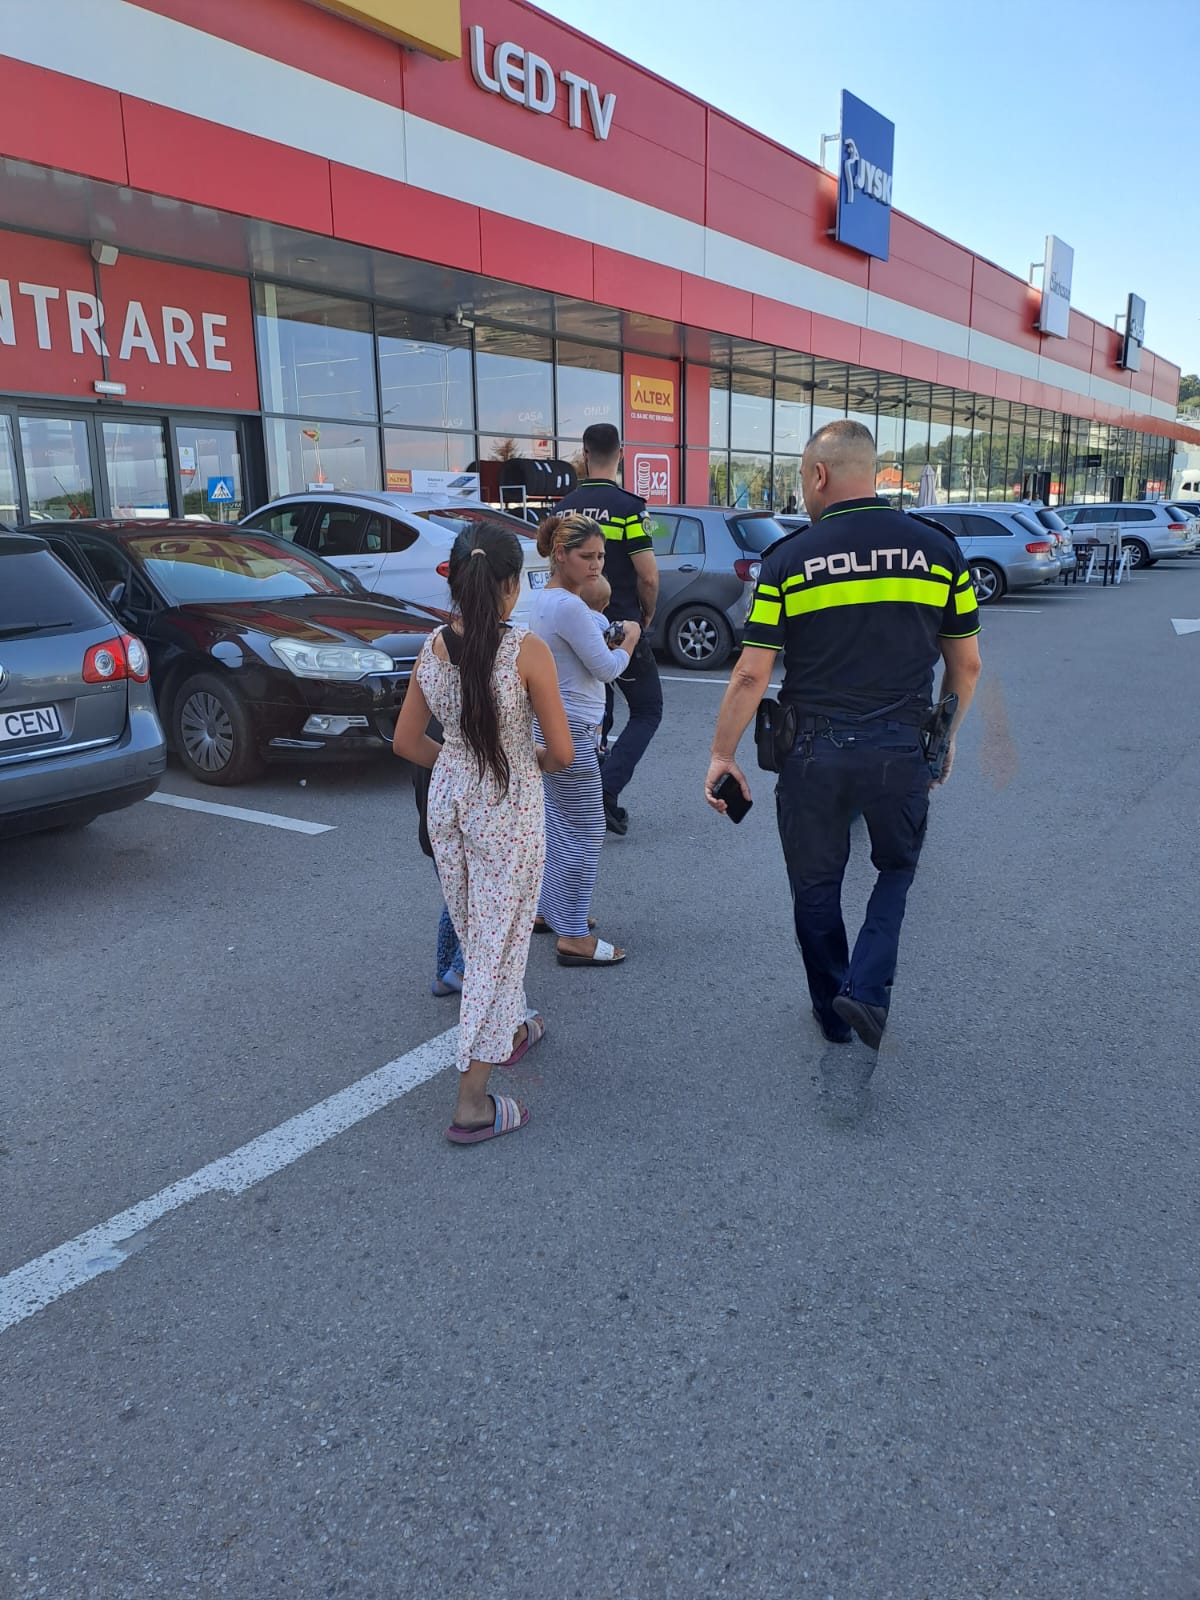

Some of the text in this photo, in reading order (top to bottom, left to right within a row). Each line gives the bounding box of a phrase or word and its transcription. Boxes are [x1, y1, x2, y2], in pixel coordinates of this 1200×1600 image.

[469, 25, 616, 140] LED TV
[854, 158, 892, 206] JYSK
[650, 471, 668, 490] X2
[803, 548, 930, 581] POLITIA
[4, 709, 54, 736] CEN
